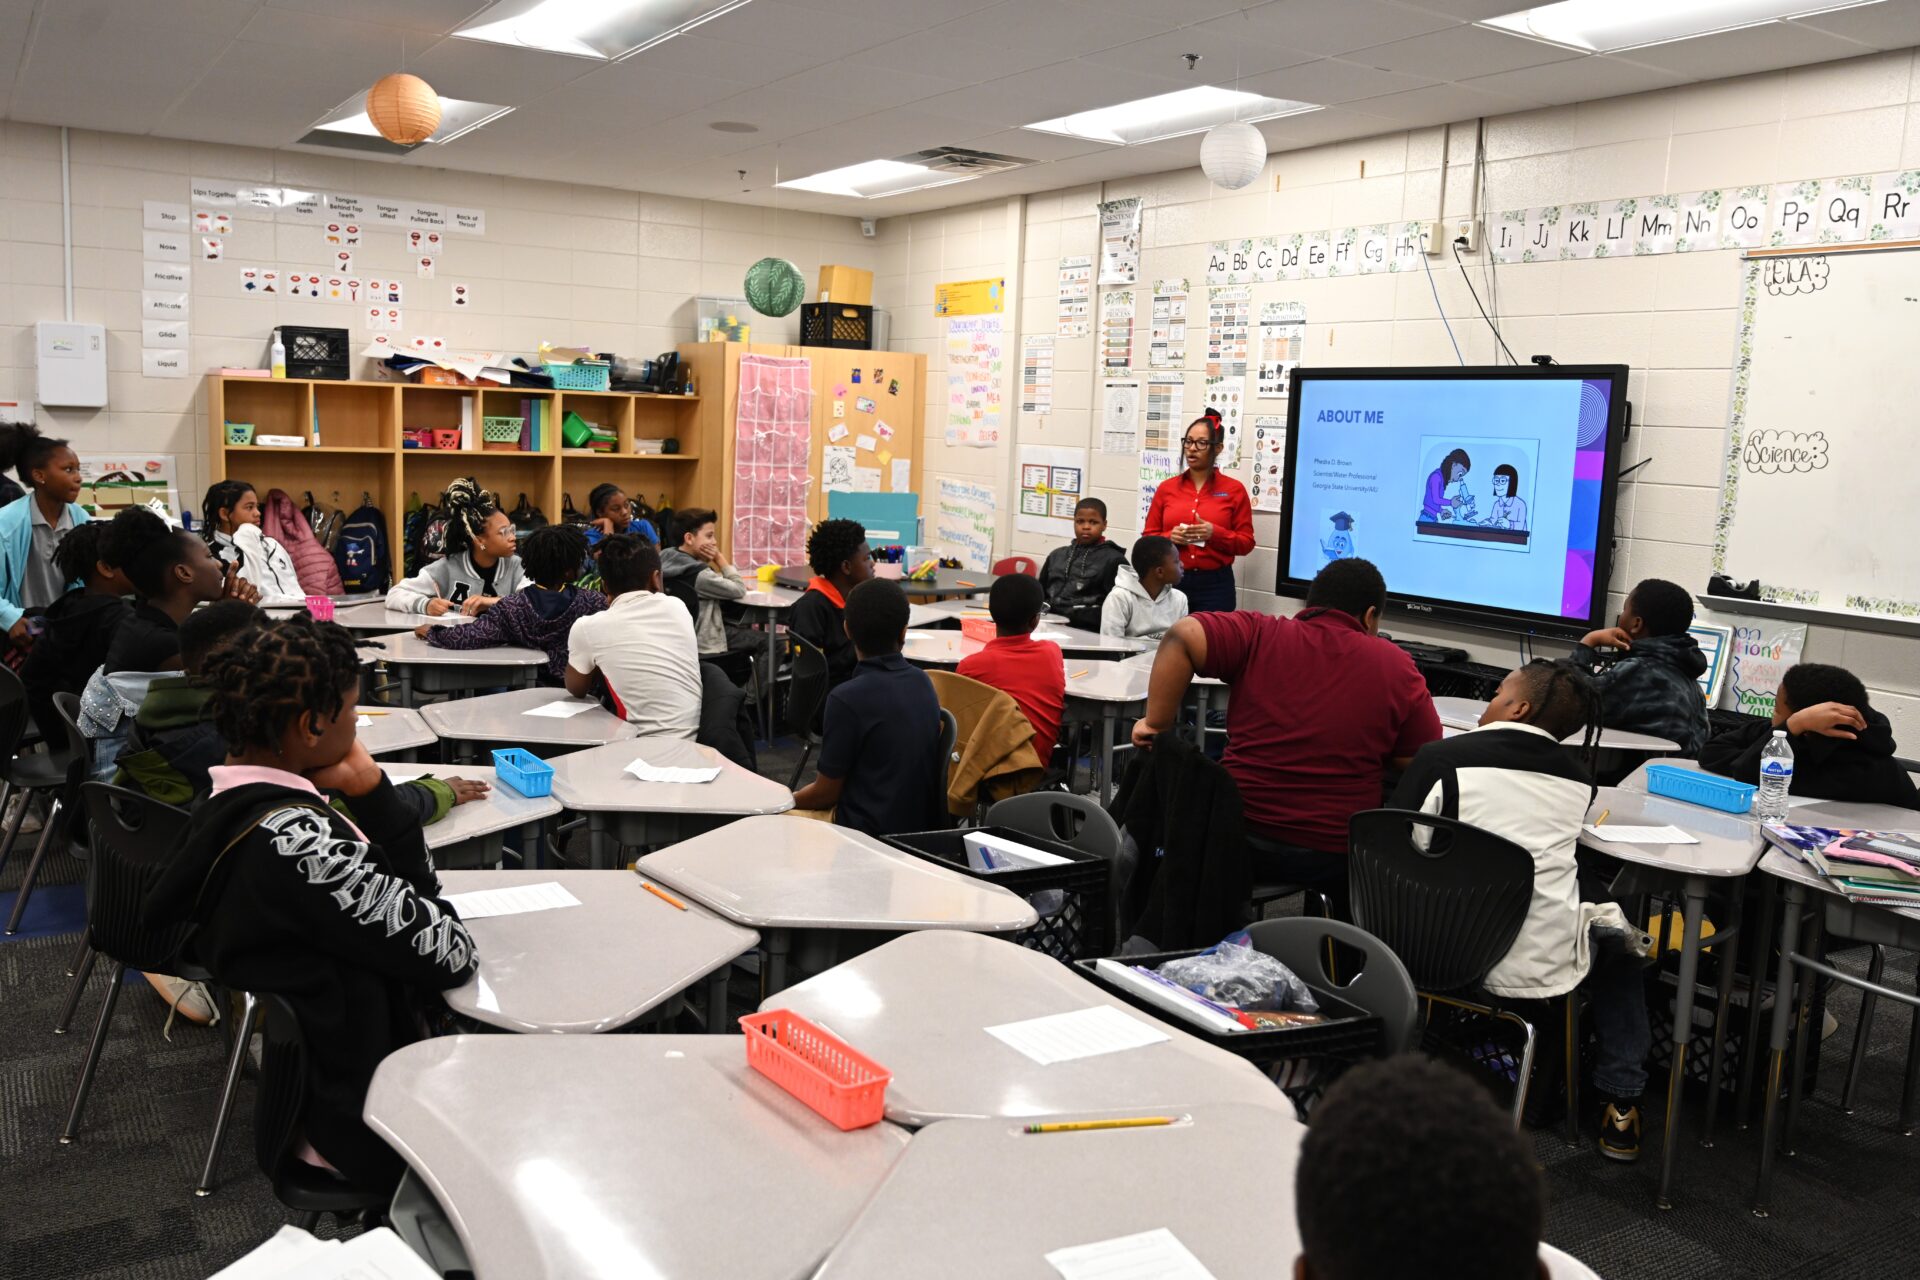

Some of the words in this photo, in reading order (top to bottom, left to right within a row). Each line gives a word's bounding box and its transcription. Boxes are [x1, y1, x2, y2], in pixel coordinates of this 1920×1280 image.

[193, 188, 206, 197] Lips
[208, 189, 236, 199] Together
[335, 196, 357, 204] Tongue
[296, 206, 313, 214] Teeth
[330, 203, 350, 211] Behind
[352, 205, 363, 213] Top
[376, 204, 399, 213] Tongue
[161, 212, 176, 221] Stop
[379, 212, 396, 220] Lifted
[417, 209, 439, 217] Tongue
[456, 213, 470, 221] Back
[410, 216, 429, 224] Pulled
[430, 217, 444, 225] Back
[458, 220, 476, 228] Throat
[1500, 227, 1512, 248] Ii
[1533, 223, 1549, 249] Jj
[1569, 220, 1589, 243] Kk
[1606, 216, 1625, 240] Ll
[1641, 214, 1672, 237] Mm
[1686, 210, 1711, 233] Nn
[1731, 205, 1758, 230] Oo
[1782, 201, 1810, 232] Pp
[1828, 197, 1860, 228] Qq
[1884, 192, 1911, 219] Rr
[159, 243, 177, 251] Nose
[1208, 255, 1225, 272] Aa
[1233, 253, 1248, 271] Bb
[1257, 251, 1273, 269] Cc
[1281, 247, 1299, 267] Dd
[1309, 245, 1325, 265] Ee
[1335, 242, 1351, 262] Ff
[1364, 240, 1383, 263] Gg
[1395, 237, 1414, 257] Hh
[154, 272, 183, 281] Fricative
[153, 302, 182, 310] Affricate
[158, 331, 177, 339] Glide
[157, 361, 178, 369] Liquid
[1317, 410, 1361, 423] ABOUT
[1364, 410, 1384, 424] ME
[1143, 452, 1170, 472] Writing
[104, 463, 129, 471] ELA
[1348, 472, 1377, 480] Professional
[1312, 482, 1331, 490] Georgia
